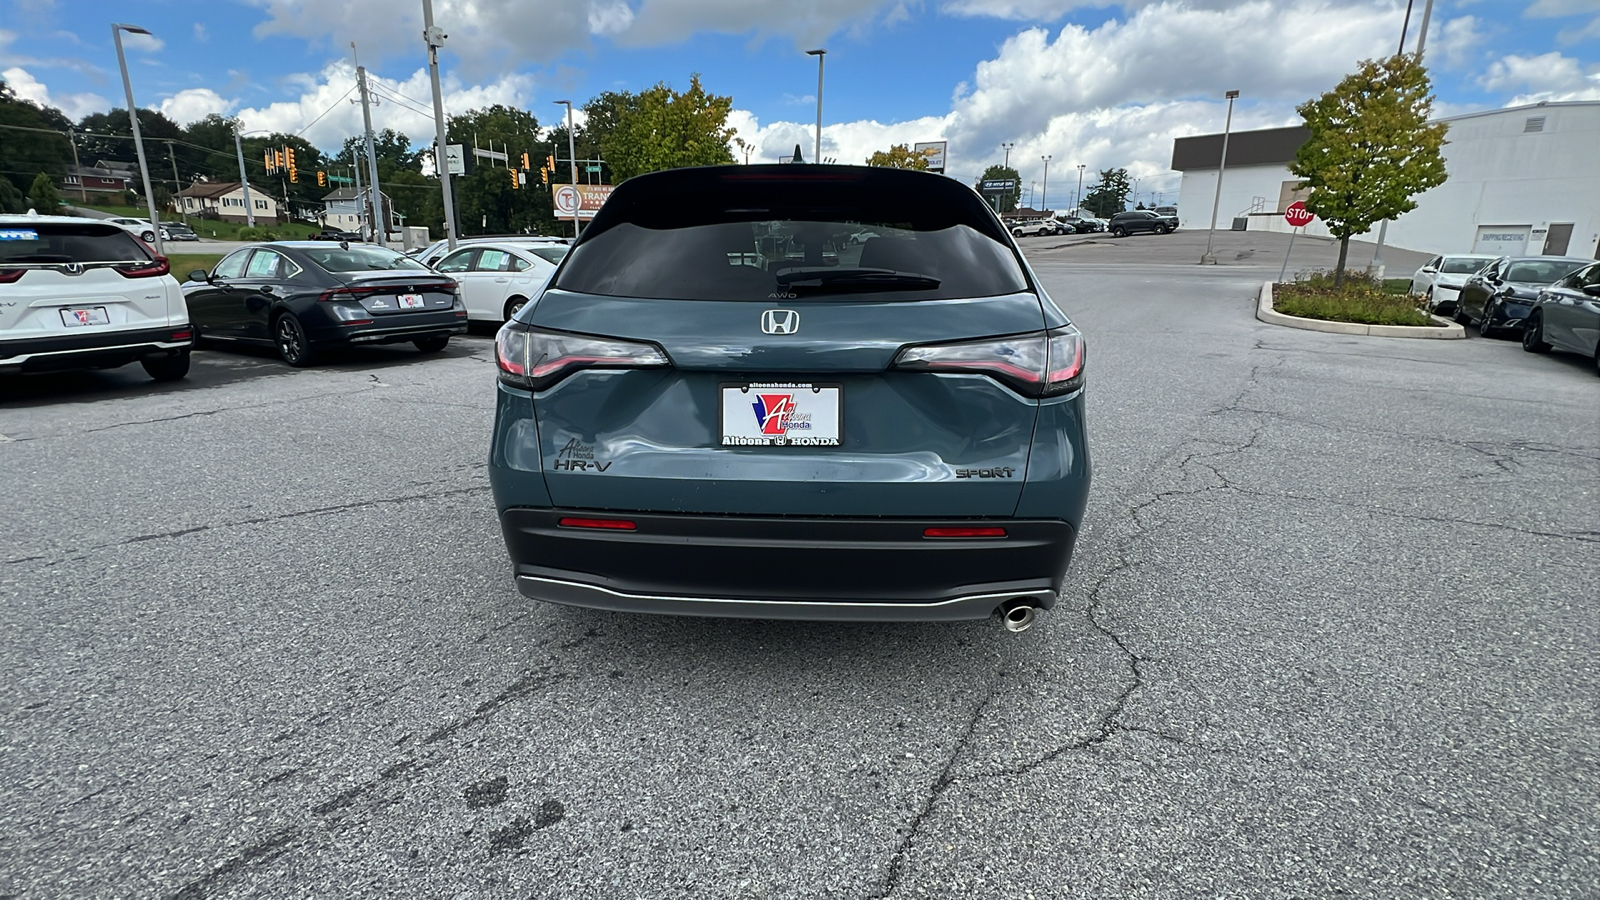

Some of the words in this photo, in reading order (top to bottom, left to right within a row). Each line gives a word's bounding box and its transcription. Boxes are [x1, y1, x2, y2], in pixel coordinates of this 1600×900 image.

[1287, 208, 1314, 219] STOP
[781, 420, 811, 429] Honda
[722, 436, 770, 446] Altoona
[791, 438, 840, 446] HONDA
[554, 460, 612, 472] HR-V
[956, 467, 1016, 478] SPORT
